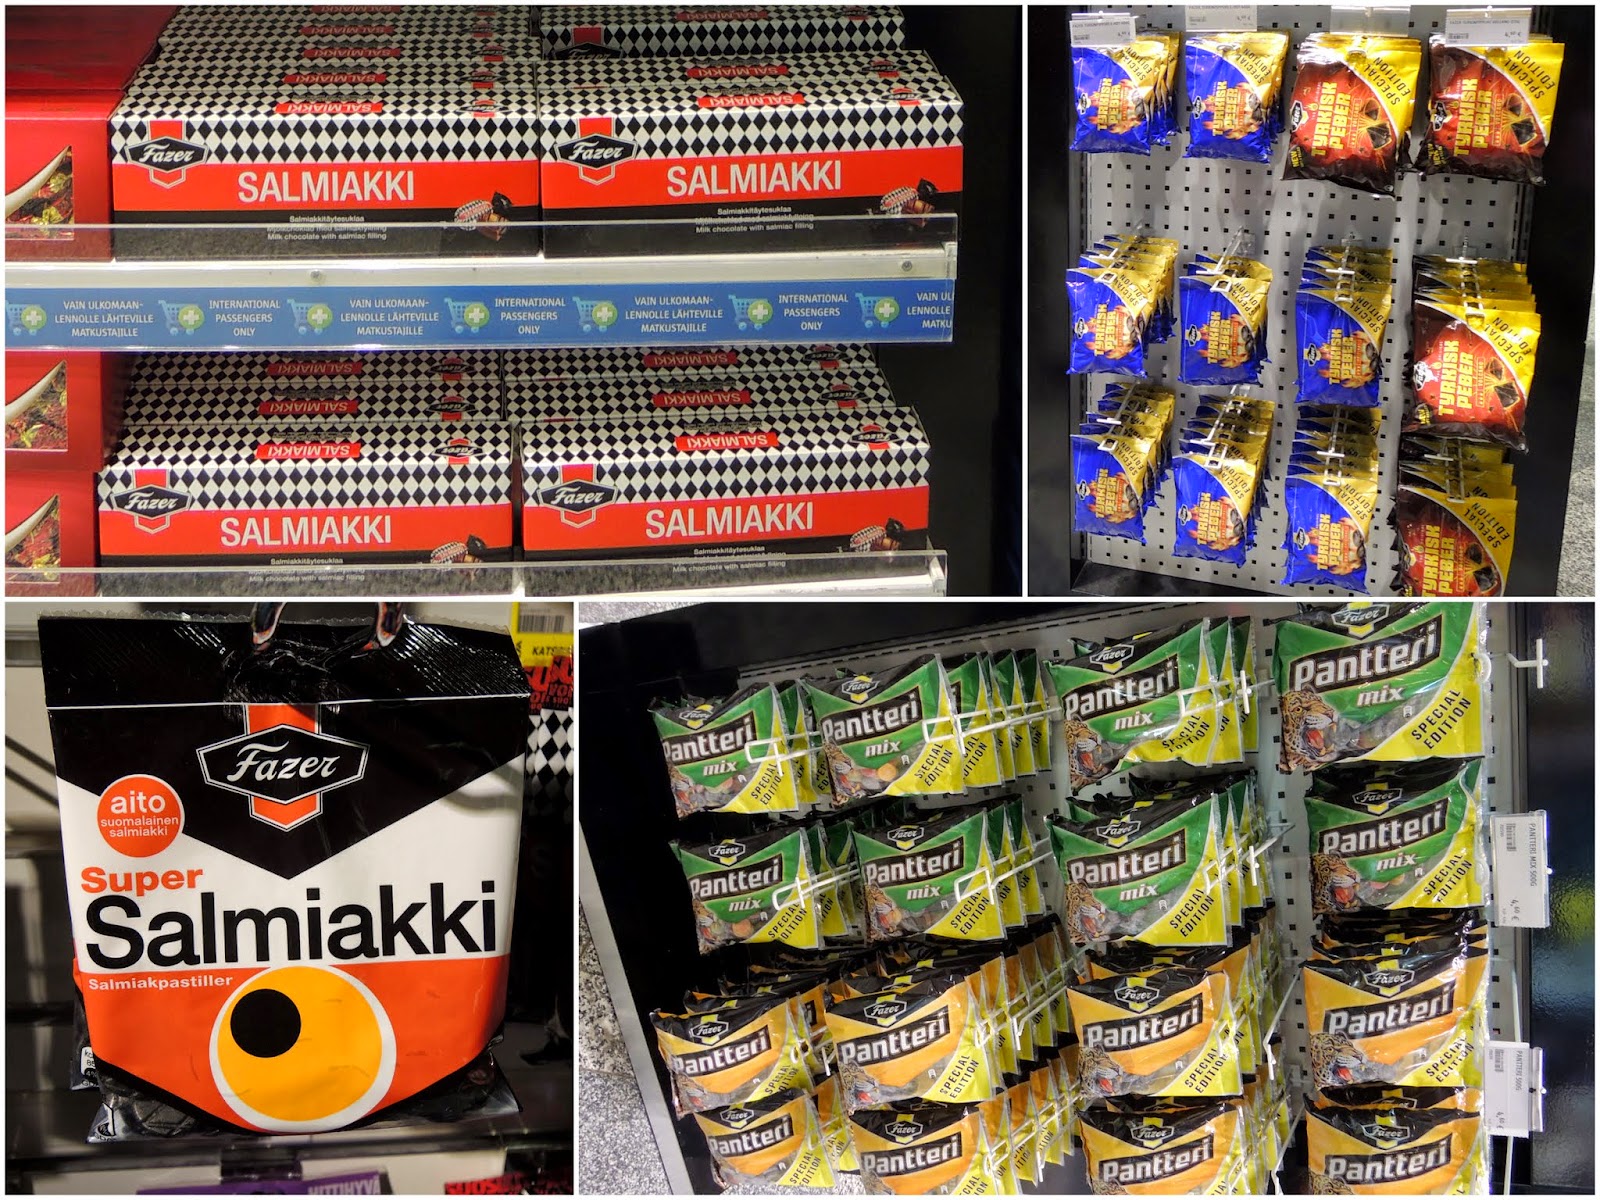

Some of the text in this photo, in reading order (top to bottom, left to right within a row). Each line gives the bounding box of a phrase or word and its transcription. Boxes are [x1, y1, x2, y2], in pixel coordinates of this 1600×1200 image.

[1364, 63, 1401, 106] SPECIAL
[1373, 57, 1412, 97] EDITION
[1508, 58, 1545, 100] SPECIAL
[1515, 50, 1556, 90] EDITION
[287, 102, 372, 113] SALMIAKKI
[709, 94, 794, 106] SALMIAKKI
[1097, 78, 1112, 131] TYRKISK
[1212, 80, 1228, 136] TYRKISK
[1226, 87, 1240, 129] PEBER
[1453, 78, 1479, 157] TYRKISK
[1311, 81, 1338, 157] TYRKISK
[1329, 93, 1352, 150] PEBER
[1473, 89, 1493, 150] PEBER
[138, 143, 196, 165] Fazer
[569, 142, 625, 162] Fazer
[238, 170, 416, 203] SALMIAKKI
[667, 160, 842, 198] SALMIAKKI
[367, 233, 387, 241] filling
[696, 226, 710, 234] Milk
[63, 300, 143, 310] VAIN ULKOMAAN-
[208, 299, 281, 309] INTERNATIONAL
[349, 298, 429, 309] VAIN ULKOMAAN-
[494, 297, 566, 307] INTERNATIONAL
[625, 307, 723, 320] LENNOLLE LÄHTEVILLE
[634, 295, 713, 306] VAIN ULKOMAAN-
[778, 293, 849, 304] INTERNATIONAL
[783, 307, 841, 318] PASSENGERS
[907, 305, 950, 316] LENNOLLE
[916, 291, 939, 302] VAIN
[54, 312, 154, 324] LENNOLLE LÄHTEVILLE
[71, 327, 139, 337] MATKUSTAJILLE
[215, 313, 273, 323] PASSENGERS
[233, 327, 256, 337] ONLY
[340, 310, 439, 322] LENNOLLE LÄHTEVILLE
[356, 326, 424, 336] MATKUSTAJILLE
[500, 311, 558, 321] PASSENGERS
[518, 325, 540, 335] ONLY
[641, 322, 707, 333] MATKUSTAJILLE
[800, 321, 823, 331] ONLY
[1350, 302, 1381, 333] SPECIAL
[1207, 311, 1222, 364] TYRKISK
[1219, 319, 1232, 359] PEBER
[1483, 323, 1524, 364] SPECIAL
[1329, 328, 1343, 385] TYRKISK
[1439, 339, 1460, 416] TYRKISK
[1456, 351, 1475, 410] PEBER
[269, 401, 348, 413] SALMIAKKI
[663, 391, 741, 405] SALMIAKKI
[267, 444, 351, 456] SALMIAKKI
[686, 434, 768, 449] SALMIAKKI
[124, 492, 180, 514] Fazer
[551, 486, 604, 506] Fazer
[1336, 488, 1368, 520] SPECIAL
[220, 515, 392, 547] SALMIAKKI
[645, 502, 814, 539] SALMIAKKI
[1463, 508, 1502, 549] SPECIAL
[1471, 502, 1511, 540] EDITION
[1316, 513, 1331, 571] TYRKISK
[1328, 522, 1342, 566] PEBER
[1438, 537, 1456, 594] PEBER
[1341, 608, 1381, 624] Fazer
[1294, 621, 1439, 691] Pantteri
[1065, 660, 1176, 720] Pantteri
[1357, 684, 1406, 708] mix
[821, 693, 919, 744] Pantteri
[1114, 711, 1154, 731] mix
[1411, 688, 1461, 741] SPECIAL
[1423, 697, 1472, 750] EDITION
[665, 717, 753, 762] Pantteri
[865, 738, 901, 758] mix
[226, 739, 341, 781] Fazer
[703, 759, 738, 778] mix
[924, 748, 953, 788] EDITION
[751, 761, 777, 800] SPECIAL
[110, 789, 166, 815] aito
[100, 815, 180, 828] suomalainen
[109, 825, 169, 838] salmiakki
[1323, 804, 1442, 855] Pantteri
[713, 844, 740, 857] Fazer
[866, 842, 962, 885] Pantteri
[1070, 835, 1182, 885] Pantteri
[1376, 852, 1417, 872] mix
[80, 866, 204, 897] Super
[689, 858, 781, 899] Pantteri
[906, 883, 942, 902] mix
[1119, 883, 1159, 902] mix
[1423, 852, 1464, 896] SPECIAL
[729, 896, 763, 914] mix
[767, 902, 801, 939] SPECIAL
[950, 888, 983, 930] SPECIAL
[960, 895, 990, 936] EDITION
[1180, 895, 1215, 938] EDITION
[85, 879, 497, 970] Salmiakki
[88, 974, 234, 991] Salmiakpastiller
[1122, 988, 1153, 1000] Fazer
[1371, 971, 1407, 985] Fazer
[868, 1002, 902, 1018] Fazer
[1087, 1000, 1201, 1048] Pantteri
[1329, 986, 1449, 1037] Pantteri
[674, 1032, 768, 1075] Pantteri
[842, 1013, 946, 1064] Pantteri
[1426, 1034, 1467, 1078] SPECIAL
[940, 1054, 970, 1096] SPECIAL
[949, 1059, 979, 1100] EDITION
[1184, 1046, 1219, 1088] SPECIAL
[1435, 1043, 1475, 1083] EDITION
[709, 1117, 791, 1157] Pantteri
[863, 1134, 960, 1175] Pantteri
[789, 1149, 813, 1186] SPECIAL
[1102, 1140, 1212, 1183] Pantteri
[1329, 1141, 1447, 1183] Pantteri
